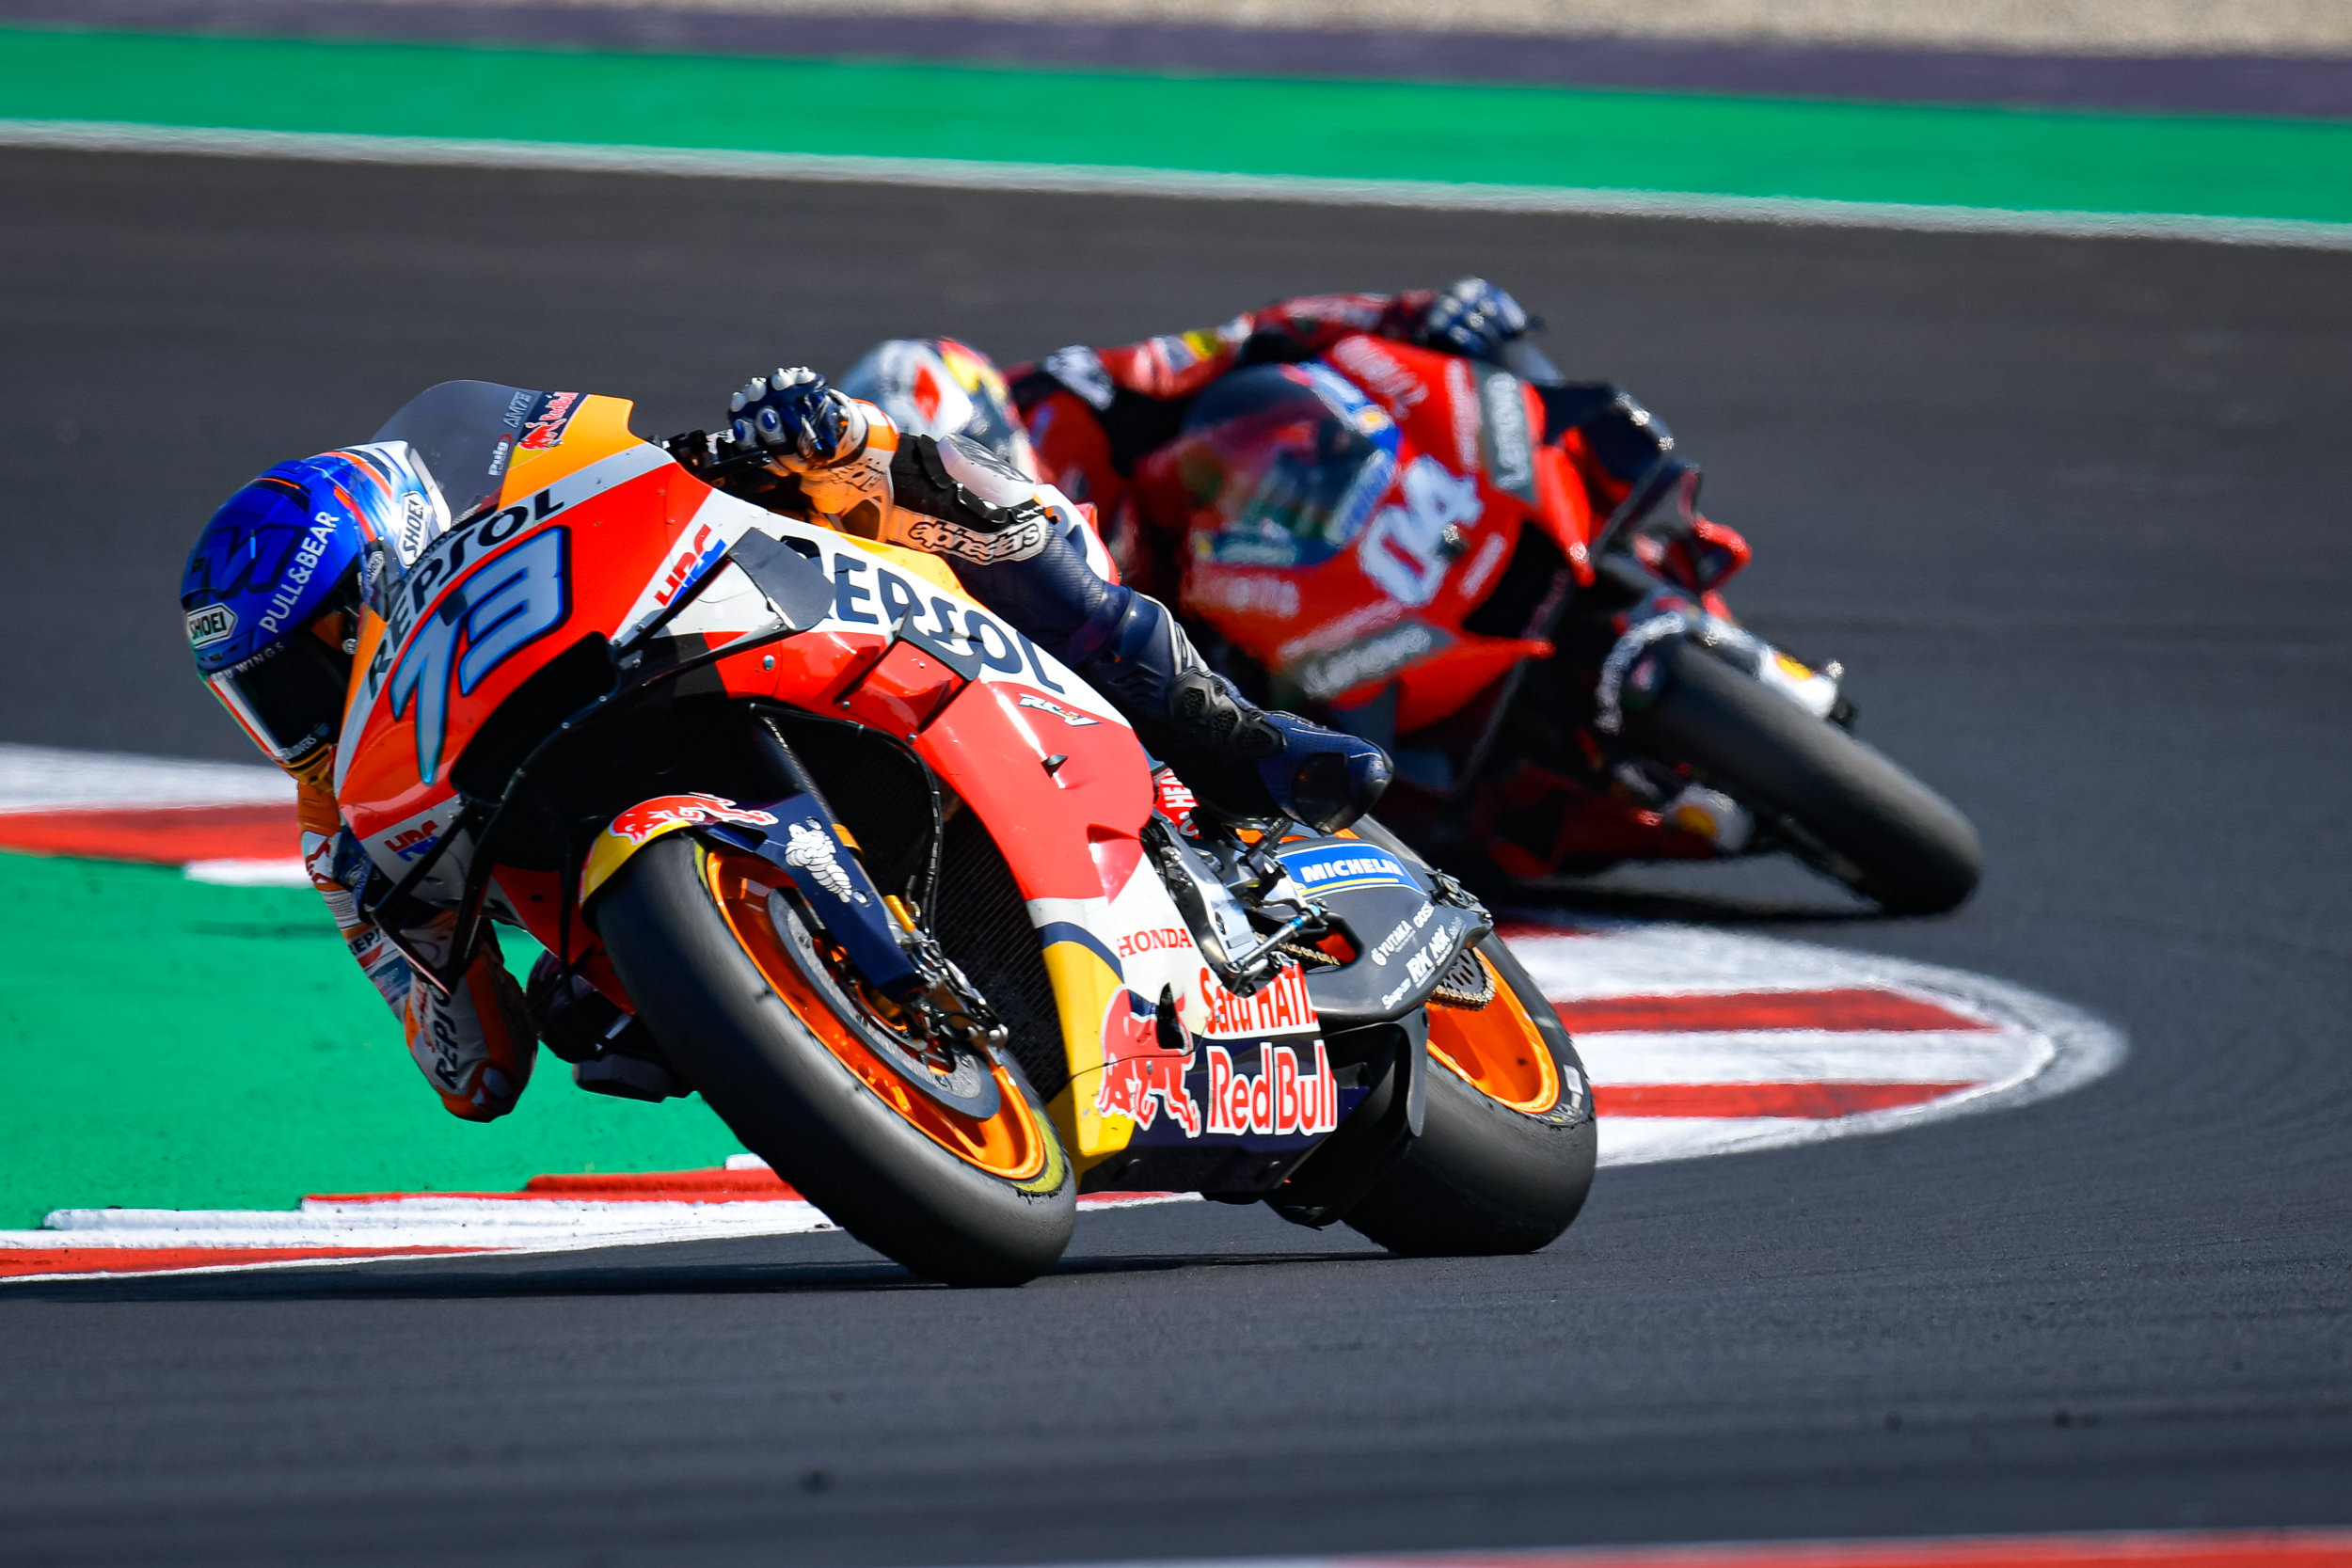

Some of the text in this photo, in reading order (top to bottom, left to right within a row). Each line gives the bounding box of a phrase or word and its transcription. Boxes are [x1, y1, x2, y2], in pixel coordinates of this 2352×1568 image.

[403, 499, 424, 553] SHOEI
[909, 521, 1041, 561] alpinestars
[1358, 454, 1484, 608] 04
[259, 511, 340, 634] PULL&BEAR
[368, 488, 564, 700] REPSOL
[189, 610, 228, 641] SHOEI
[804, 546, 1065, 694] EPSOL
[234, 641, 284, 673] WINGS
[389, 524, 576, 787] 73
[1300, 858, 1405, 883] MICHELIN
[1117, 927, 1194, 958] HONDA
[1378, 919, 1414, 958] YUTAKA
[1406, 945, 1434, 984] RK
[1428, 924, 1451, 959] NGK
[431, 983, 459, 1089] REPSO
[1207, 1039, 1338, 1135] Red Bull
